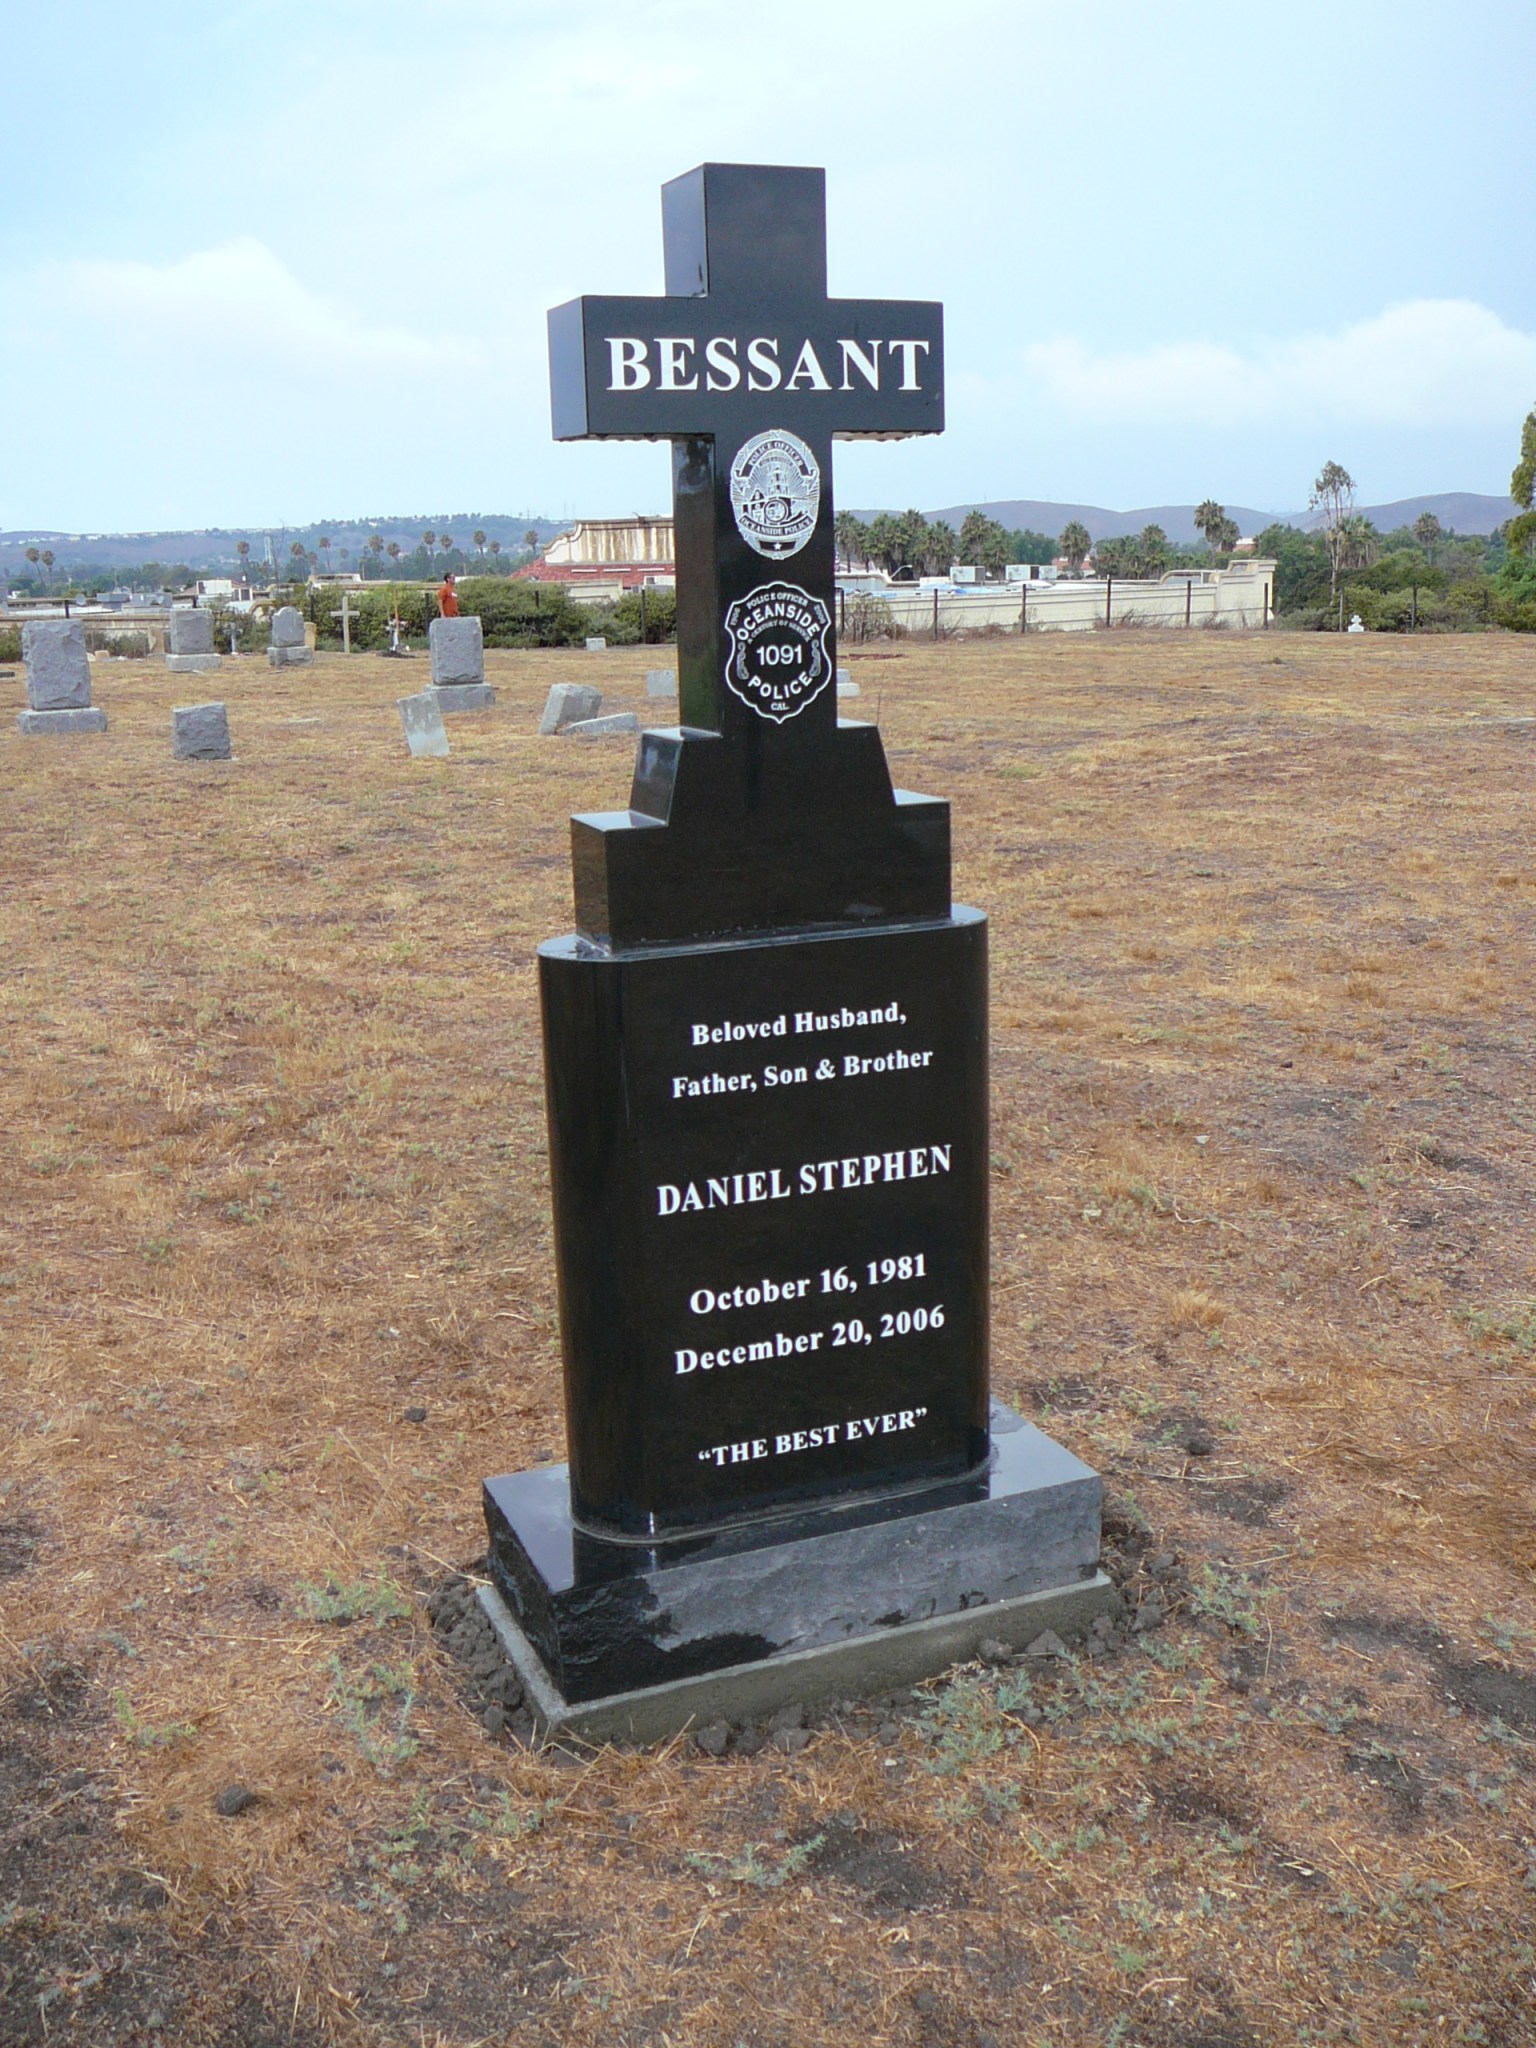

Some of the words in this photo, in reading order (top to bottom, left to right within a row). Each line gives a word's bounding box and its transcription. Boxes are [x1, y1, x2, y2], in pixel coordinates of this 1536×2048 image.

[604, 337, 930, 392] BESSANT
[748, 441, 774, 466] POLICE
[740, 517, 784, 535] OCEANSIDE
[784, 517, 812, 535] POLICE
[736, 603, 820, 641] OCEANSIDE
[746, 592, 776, 610] POLICE
[776, 592, 809, 608] OFFICER
[756, 644, 802, 666] 1091
[747, 671, 812, 700] POLICE
[692, 1014, 787, 1046] Beloved
[794, 1001, 907, 1035] Husband,
[672, 1072, 757, 1099] Father,
[764, 1065, 808, 1087] Son
[815, 1058, 836, 1081] &
[843, 1049, 933, 1077] Brother
[657, 1169, 791, 1216] DANIEL
[799, 1144, 952, 1195] STEPHEN
[690, 1278, 811, 1314] October
[820, 1266, 858, 1294] 16,
[867, 1253, 927, 1285] 1981
[674, 1332, 824, 1375] December
[832, 1319, 872, 1346] 20,
[880, 1304, 945, 1338] 2006
[698, 1438, 768, 1466] “THE
[775, 1424, 840, 1454] BEST
[846, 1407, 928, 1441] EVER”
